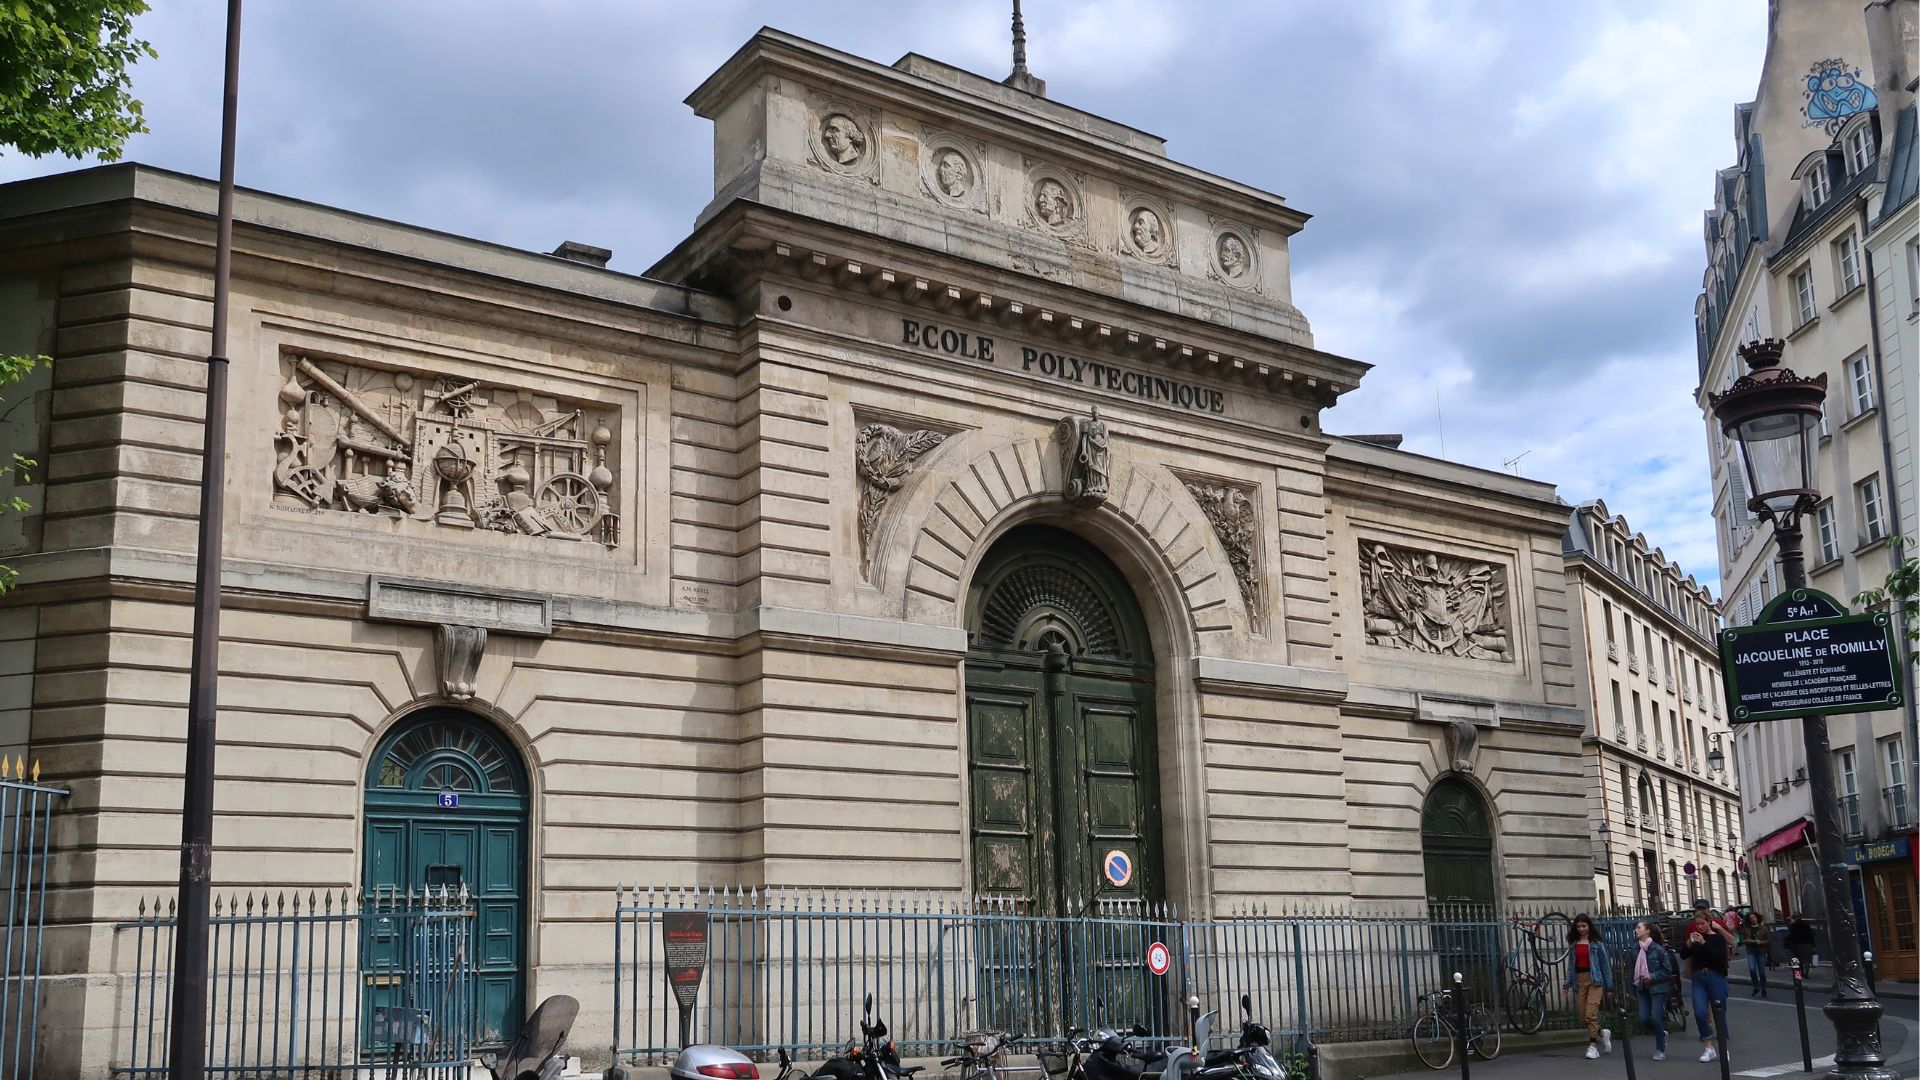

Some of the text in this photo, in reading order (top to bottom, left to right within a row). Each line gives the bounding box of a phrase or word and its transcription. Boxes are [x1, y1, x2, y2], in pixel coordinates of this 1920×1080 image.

[902, 318, 1225, 413] ECOLE POLYTECHNIQUE
[1784, 628, 1830, 643] PLACE
[1735, 639, 1885, 665] JACQUELINE DE ROMILLY
[1771, 680, 1792, 688] MEMBRE
[1829, 674, 1857, 683] FRANÇAISE
[1741, 692, 1762, 701] MEMBRE
[1798, 688, 1809, 696] DES
[1809, 685, 1843, 694] INSCRIPTIONS
[1850, 680, 1892, 690] BELLES-LETTRES
[1771, 699, 1805, 707] PROFESSEUR
[1842, 693, 1863, 701] FRANCE
[444, 795, 452, 806] 5
[1868, 844, 1896, 860] BODEGA
